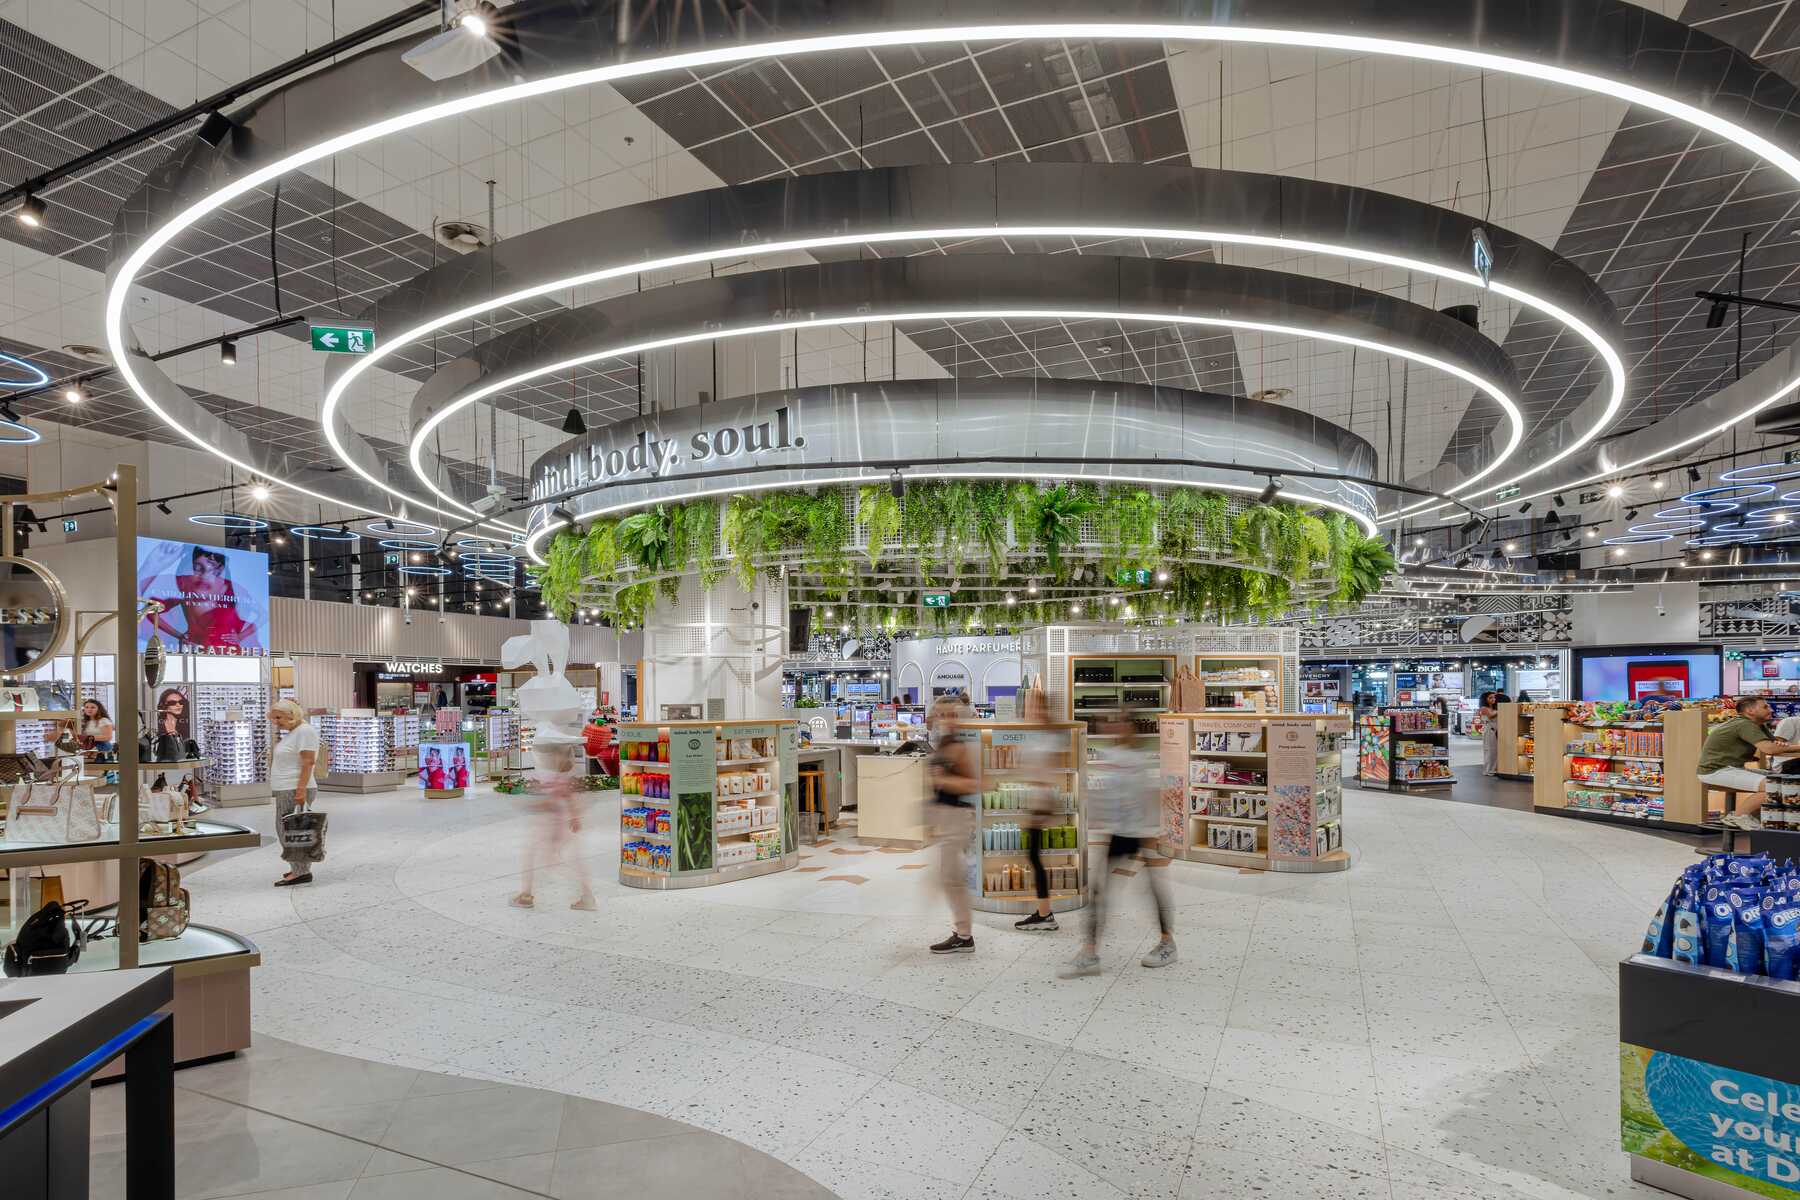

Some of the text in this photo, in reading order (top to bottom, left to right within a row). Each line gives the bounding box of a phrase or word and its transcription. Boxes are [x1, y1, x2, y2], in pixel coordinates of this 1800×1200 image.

[587, 430, 680, 482] body.
[691, 406, 806, 462] soul.
[936, 641, 1032, 655] HAUTE PARFUMERIE
[386, 662, 443, 674] WATCHES
[1712, 1144, 1754, 1171] at
